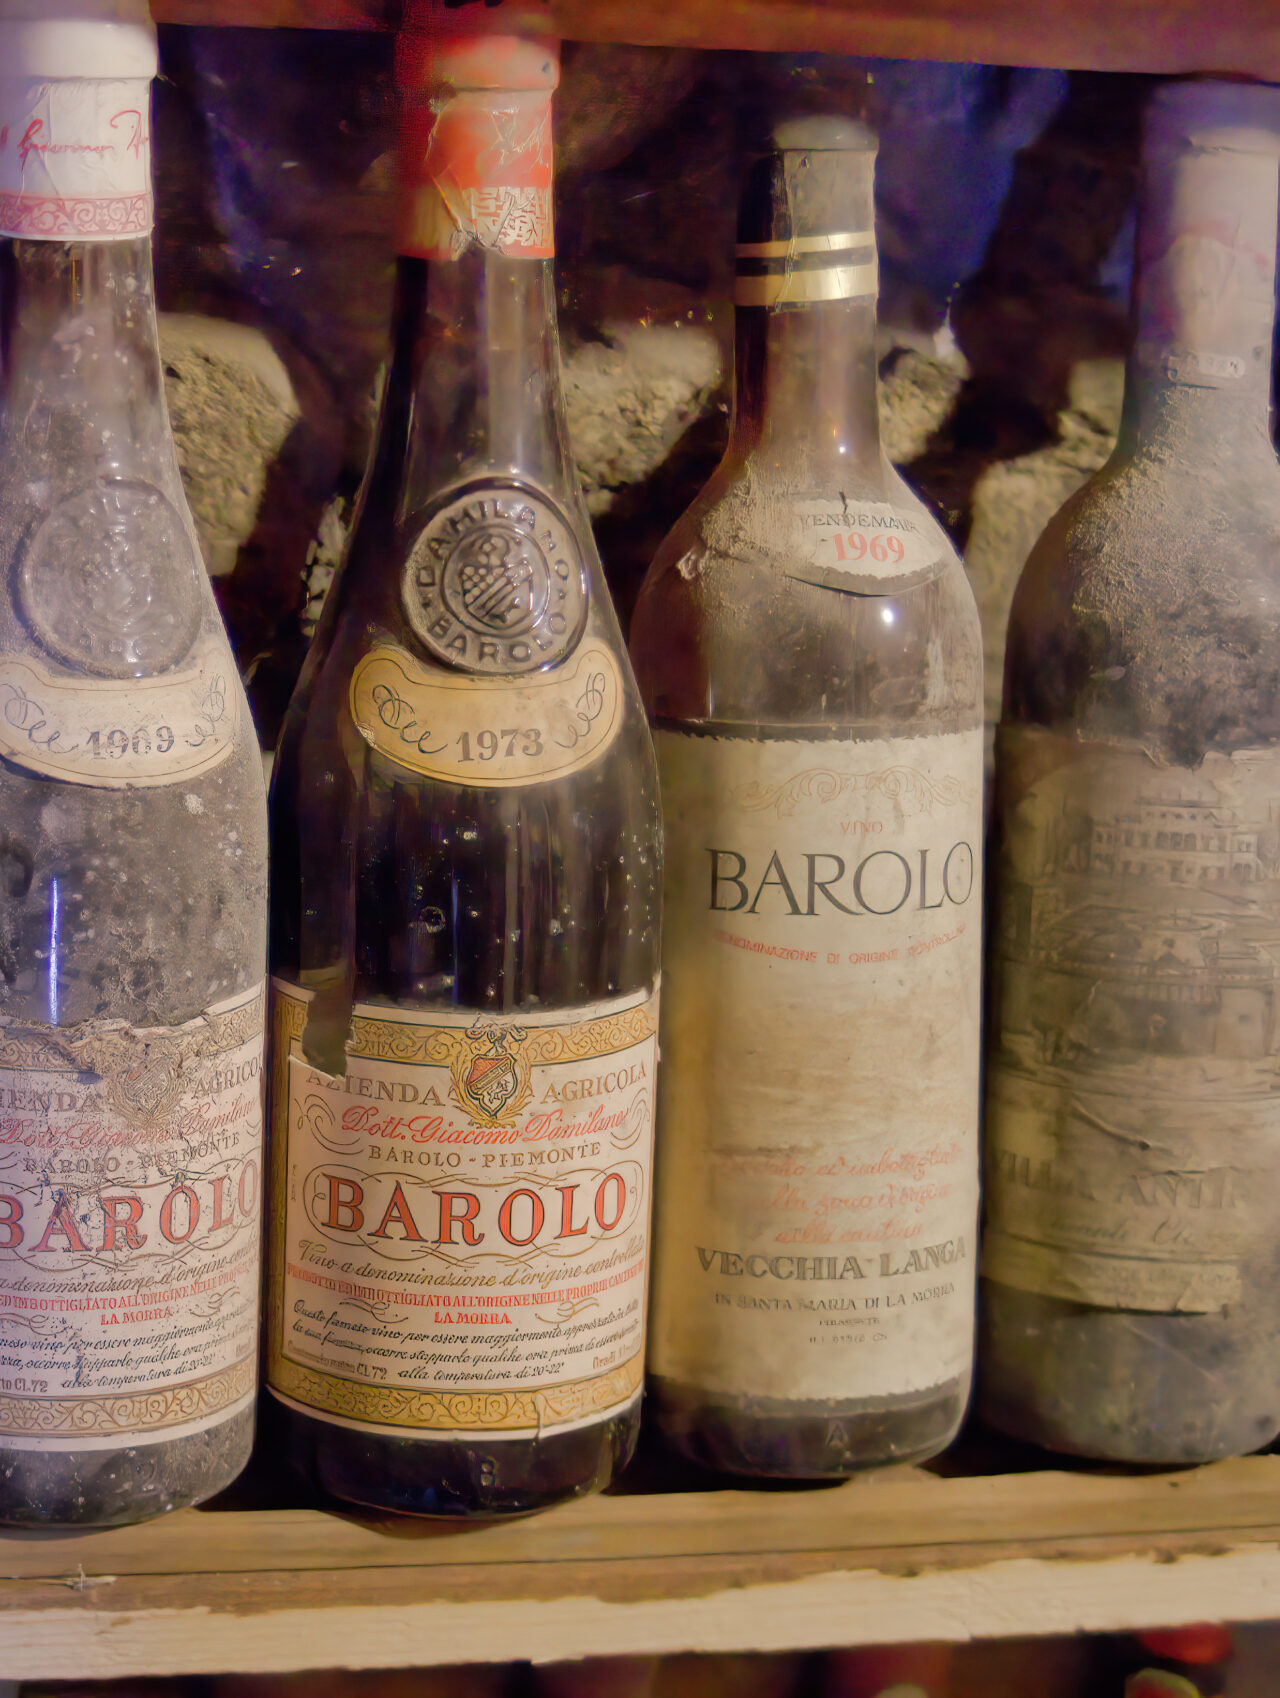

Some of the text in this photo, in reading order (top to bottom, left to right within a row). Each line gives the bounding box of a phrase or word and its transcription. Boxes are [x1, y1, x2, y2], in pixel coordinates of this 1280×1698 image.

[832, 531, 905, 563] 1969
[456, 728, 545, 763] 1973
[839, 820, 883, 835] VINO
[705, 841, 973, 917] BAROLO
[540, 1059, 647, 1105] AGRICOLA
[340, 1103, 632, 1146] Dott. Giacomo Damilano
[367, 1141, 602, 1169] BAROLO PIEMONTE
[320, 1172, 627, 1247] BAROLO
[696, 1236, 968, 1280] VECCHIA LANGA
[356, 1262, 496, 1288] denominazione
[499, 1262, 583, 1289] d'origine
[100, 1306, 174, 1325] LA MORRA
[433, 1311, 512, 1325] LA MORRA
[371, 1325, 403, 1339] vino
[470, 1325, 563, 1349] maggiormente
[397, 1366, 429, 1380] alla
